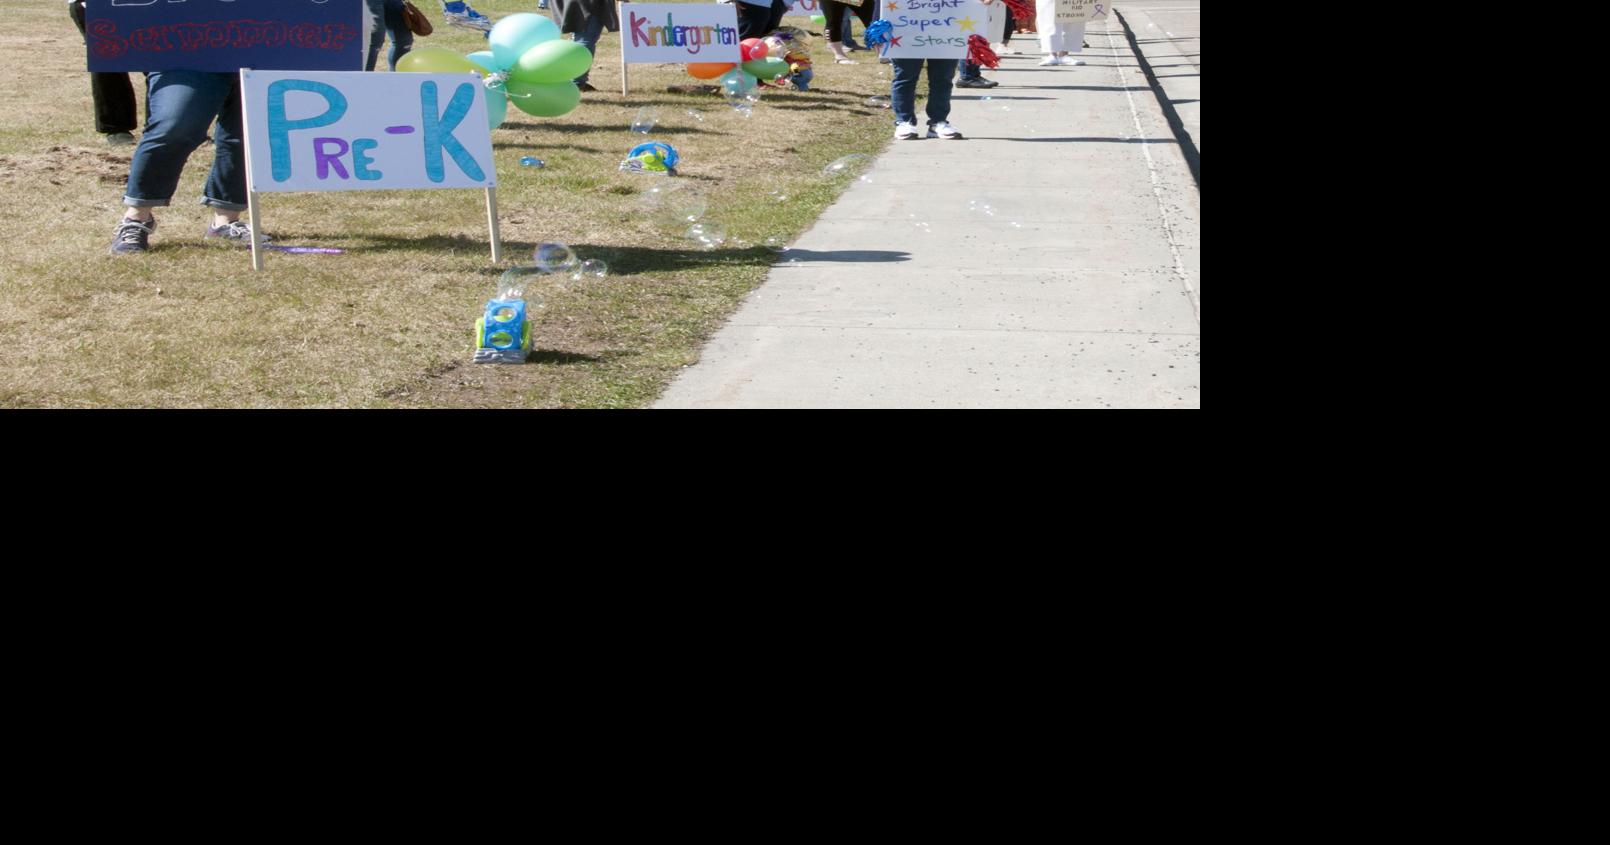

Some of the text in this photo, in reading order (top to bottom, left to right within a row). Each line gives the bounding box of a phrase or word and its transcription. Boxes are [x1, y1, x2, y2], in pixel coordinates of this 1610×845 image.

[907, 0, 964, 13] Bright
[893, 15, 957, 32] Super
[629, 11, 737, 54] Kindergarten
[911, 35, 966, 48] Stars
